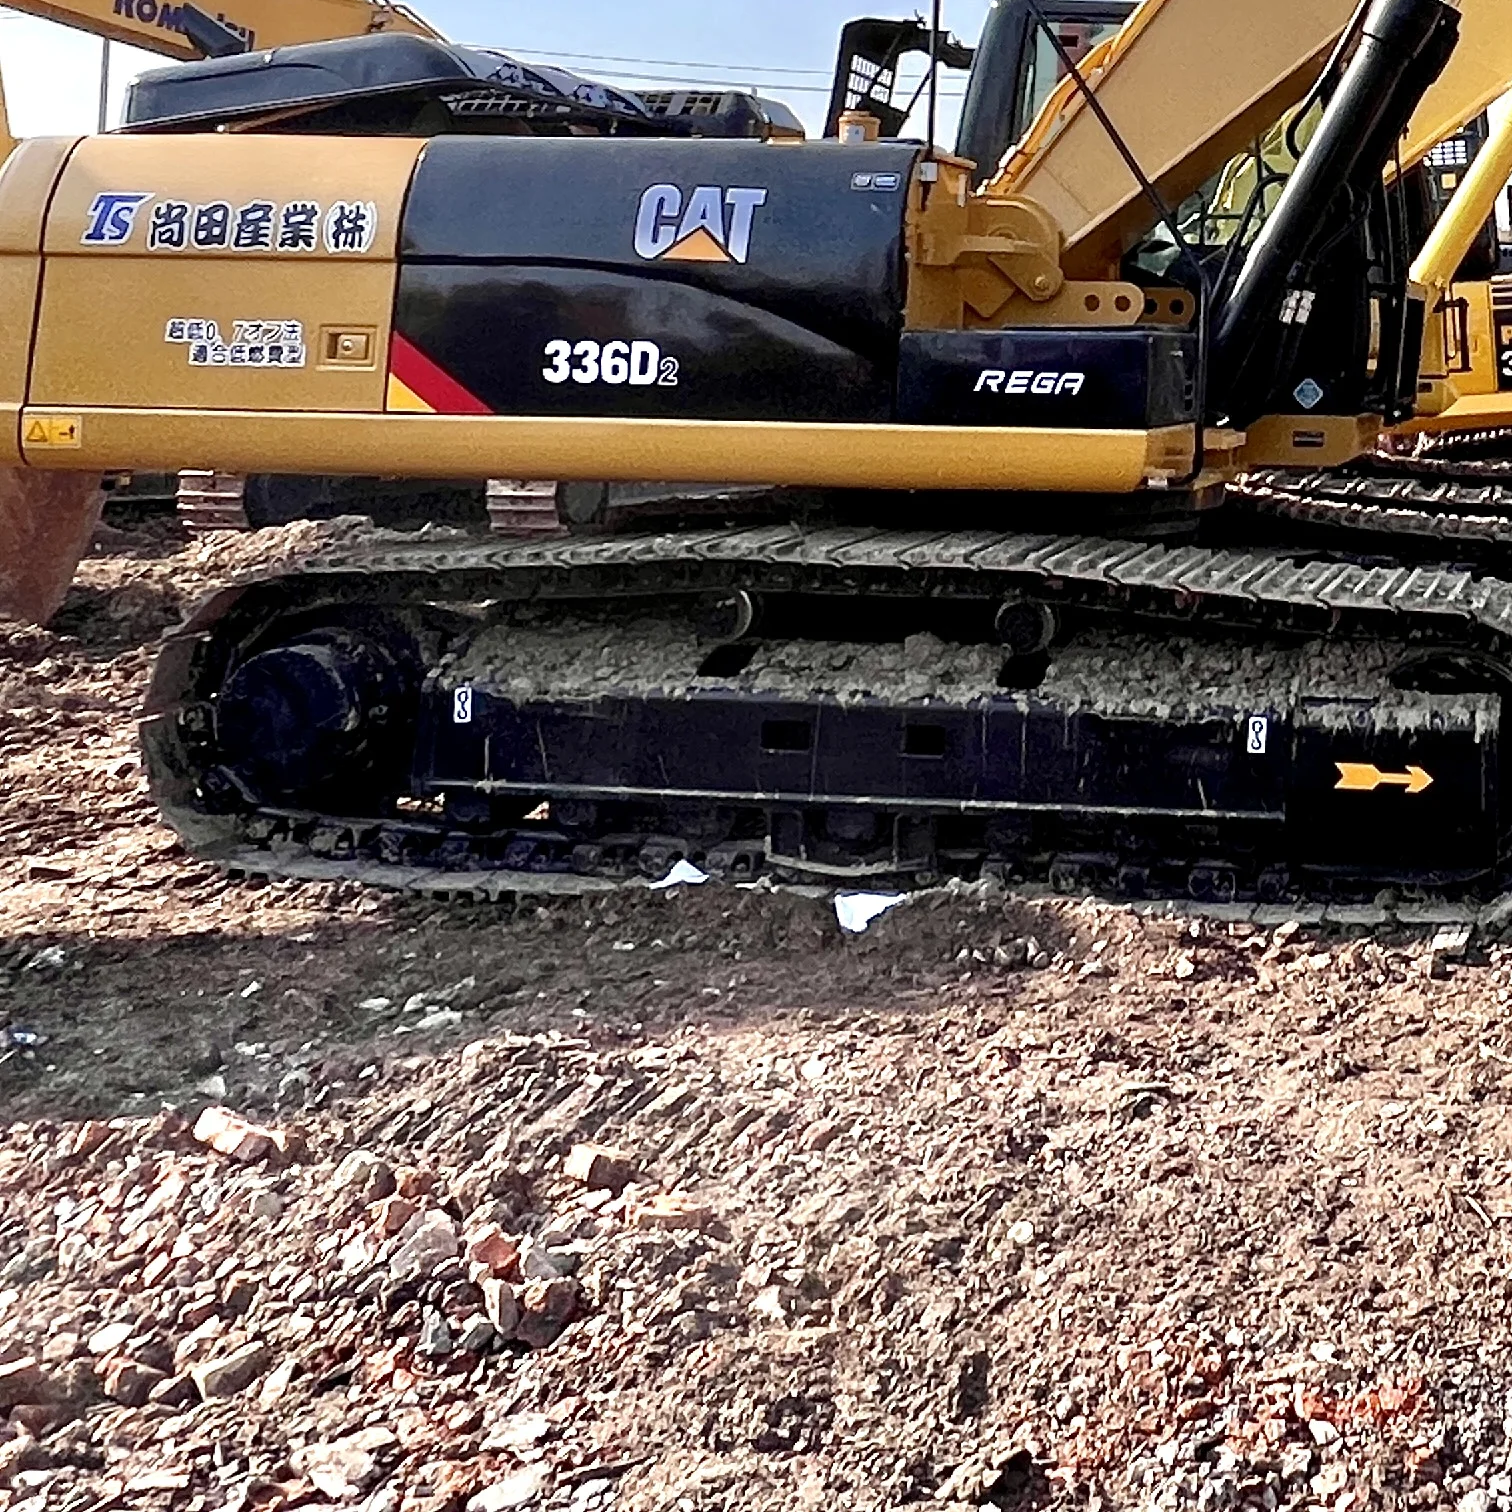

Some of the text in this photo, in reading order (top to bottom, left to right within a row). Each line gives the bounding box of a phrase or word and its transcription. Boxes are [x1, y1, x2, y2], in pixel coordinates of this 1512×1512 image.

[85, 194, 148, 241] TS
[634, 184, 768, 264] CAT
[973, 370, 1085, 395] REGA
